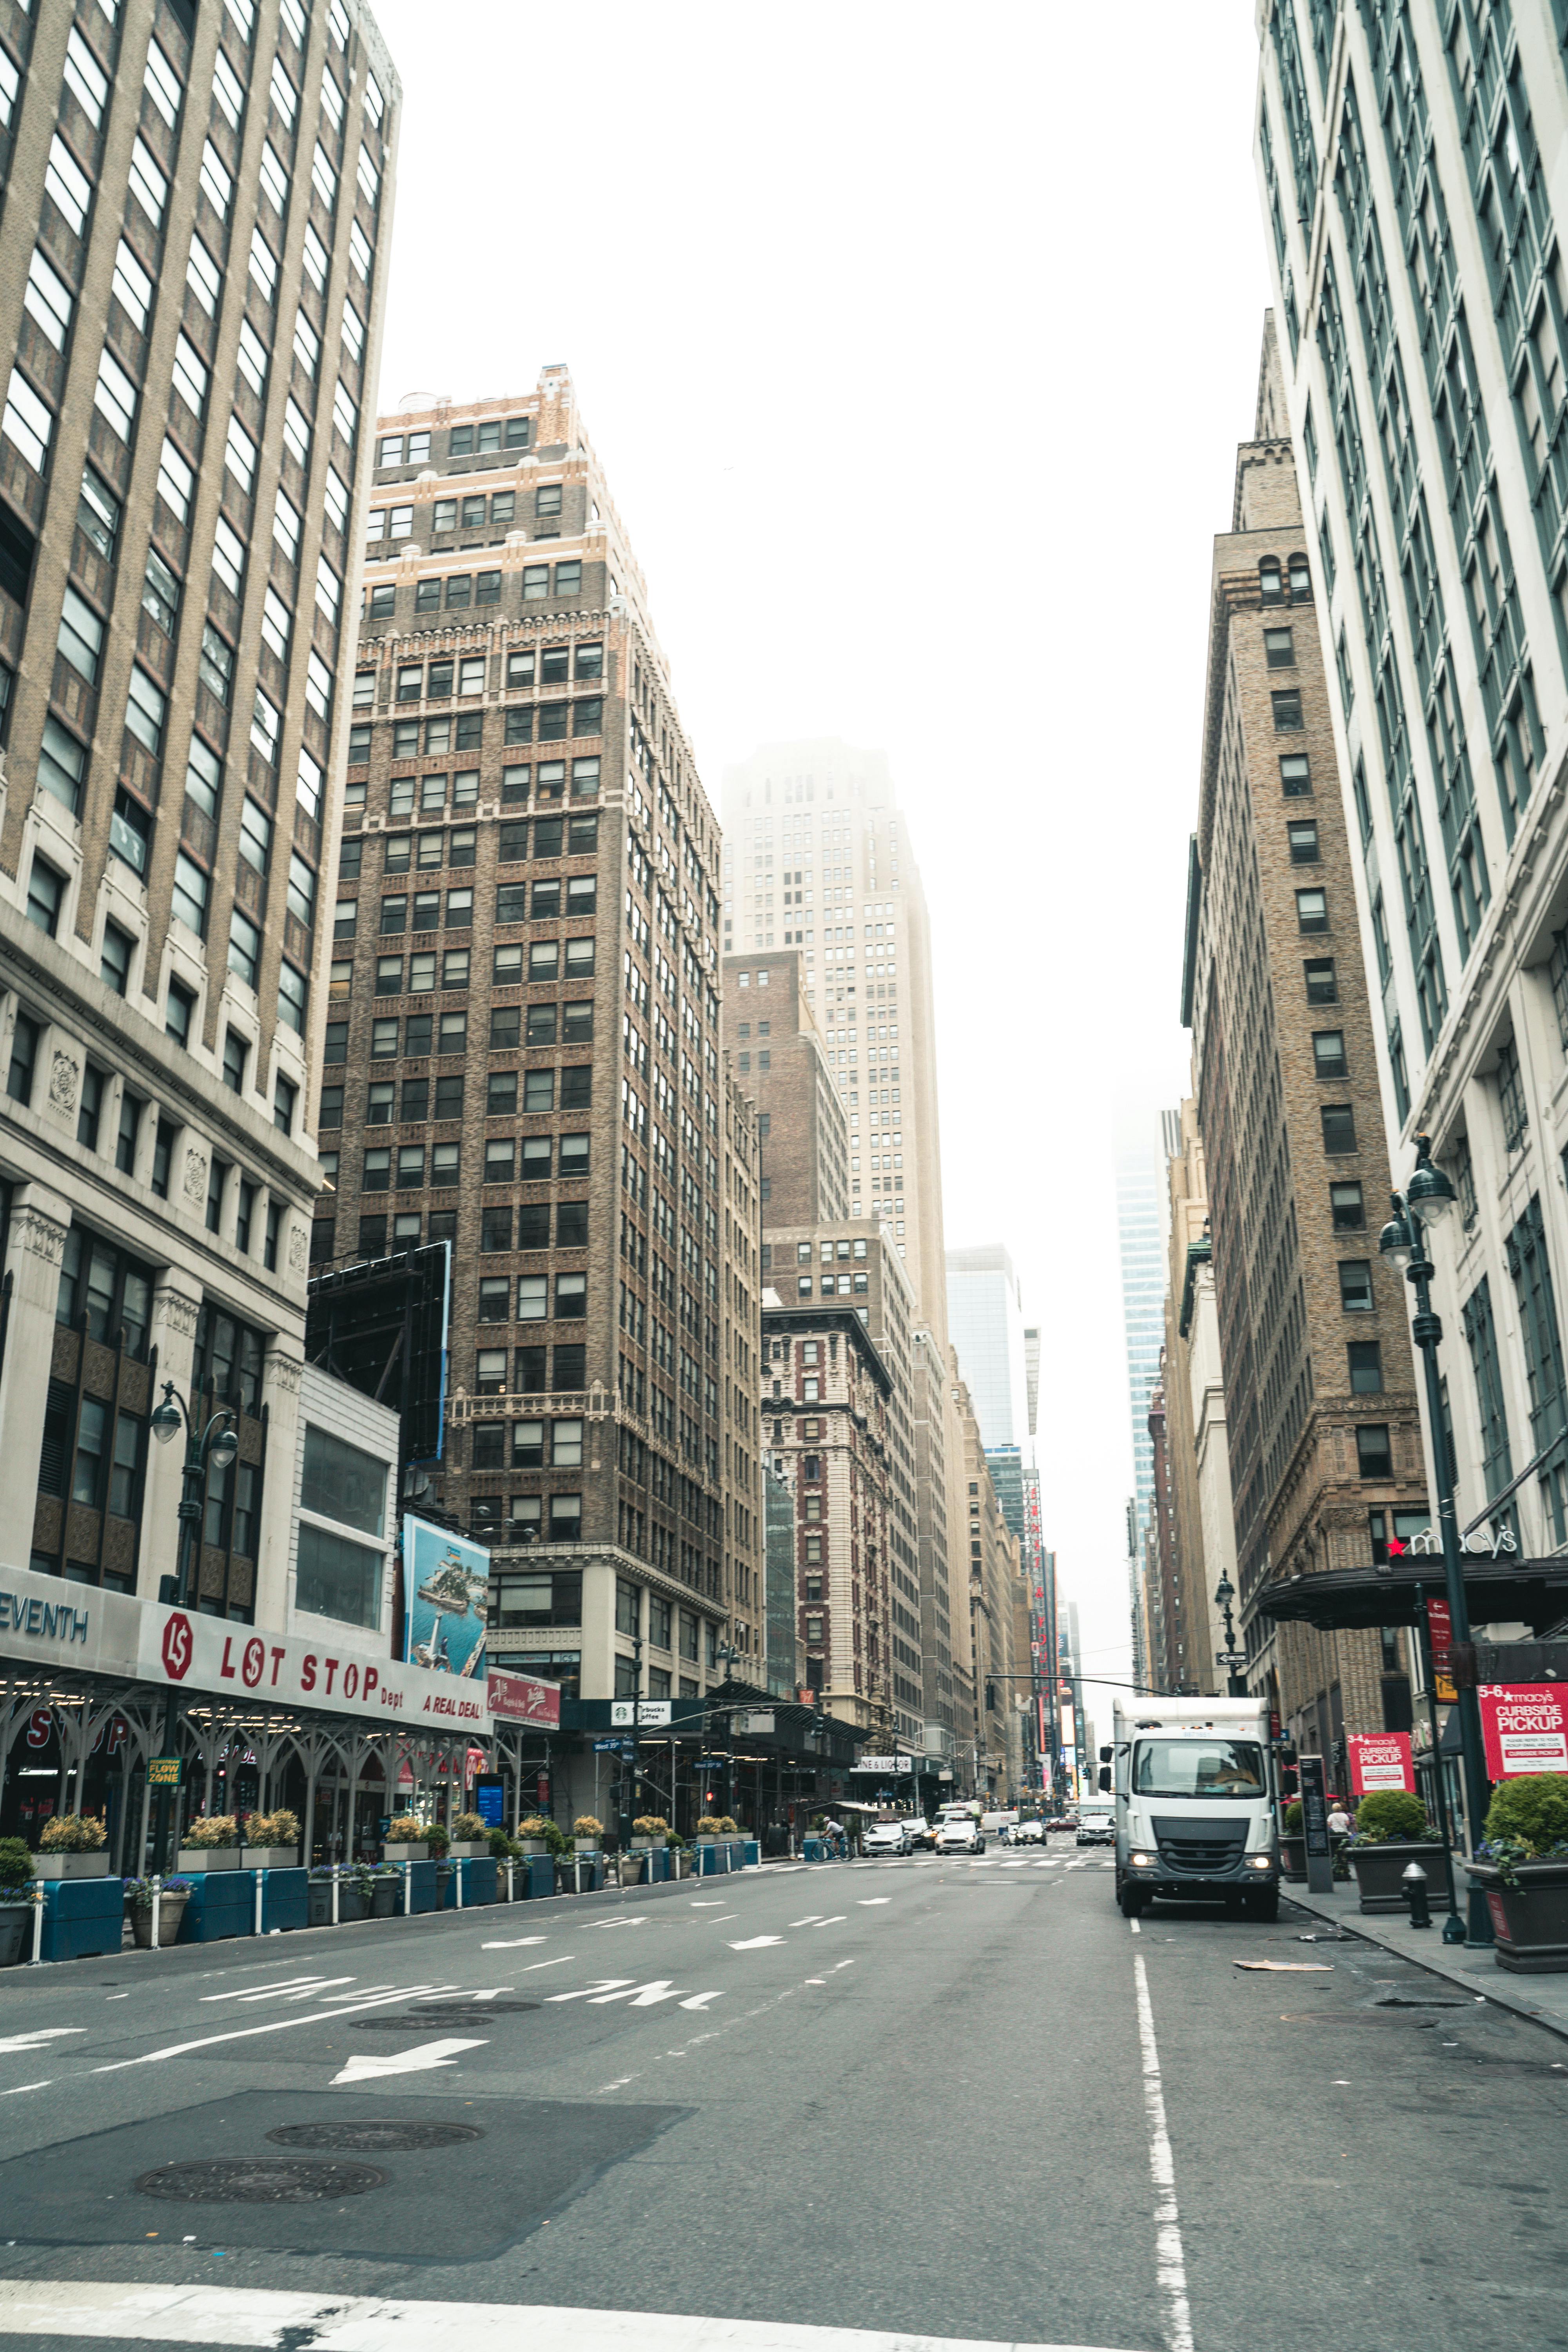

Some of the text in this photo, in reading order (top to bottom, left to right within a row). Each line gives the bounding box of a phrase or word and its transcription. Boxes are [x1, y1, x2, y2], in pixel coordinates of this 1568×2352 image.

[301, 1654, 378, 1701] STOP
[381, 1687, 403, 1711] Dept
[423, 1695, 431, 1712] A
[433, 1697, 456, 1716] REAL
[458, 1701, 483, 1719] DEAL!
[1479, 1685, 1503, 1698] 5-6
[1495, 1705, 1563, 1717] CURBSIDE
[1497, 1716, 1563, 1731] PICKUP
[1347, 1735, 1363, 1743] 3-4
[1358, 1746, 1403, 1755] CURBSIDE
[1359, 1753, 1403, 1764] PICKUP
[149, 1764, 179, 1773] FLOW
[148, 1773, 179, 1783] ZONE
